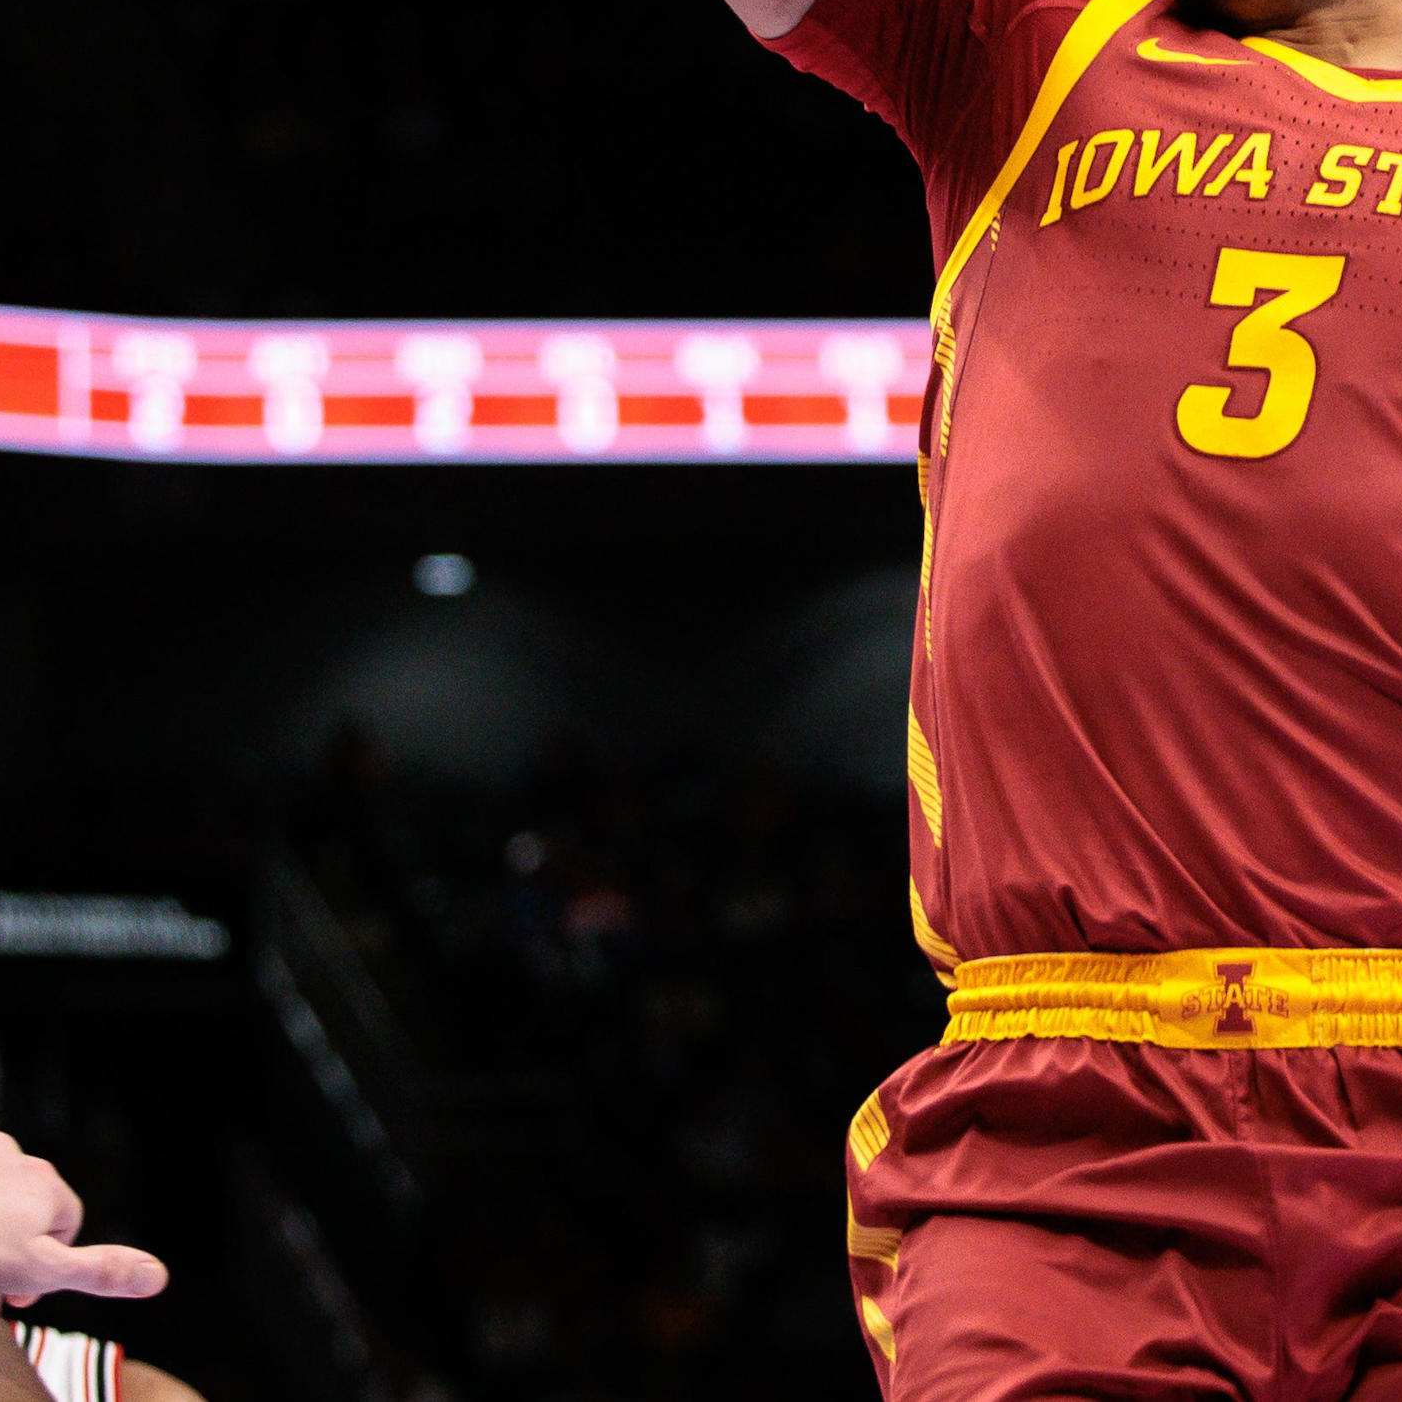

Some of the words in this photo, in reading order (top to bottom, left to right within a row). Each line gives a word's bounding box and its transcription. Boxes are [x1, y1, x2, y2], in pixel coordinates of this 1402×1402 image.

[1039, 128, 1273, 227] IOWA
[1176, 247, 1347, 459] 3
[1181, 982, 1290, 1022] STATE
